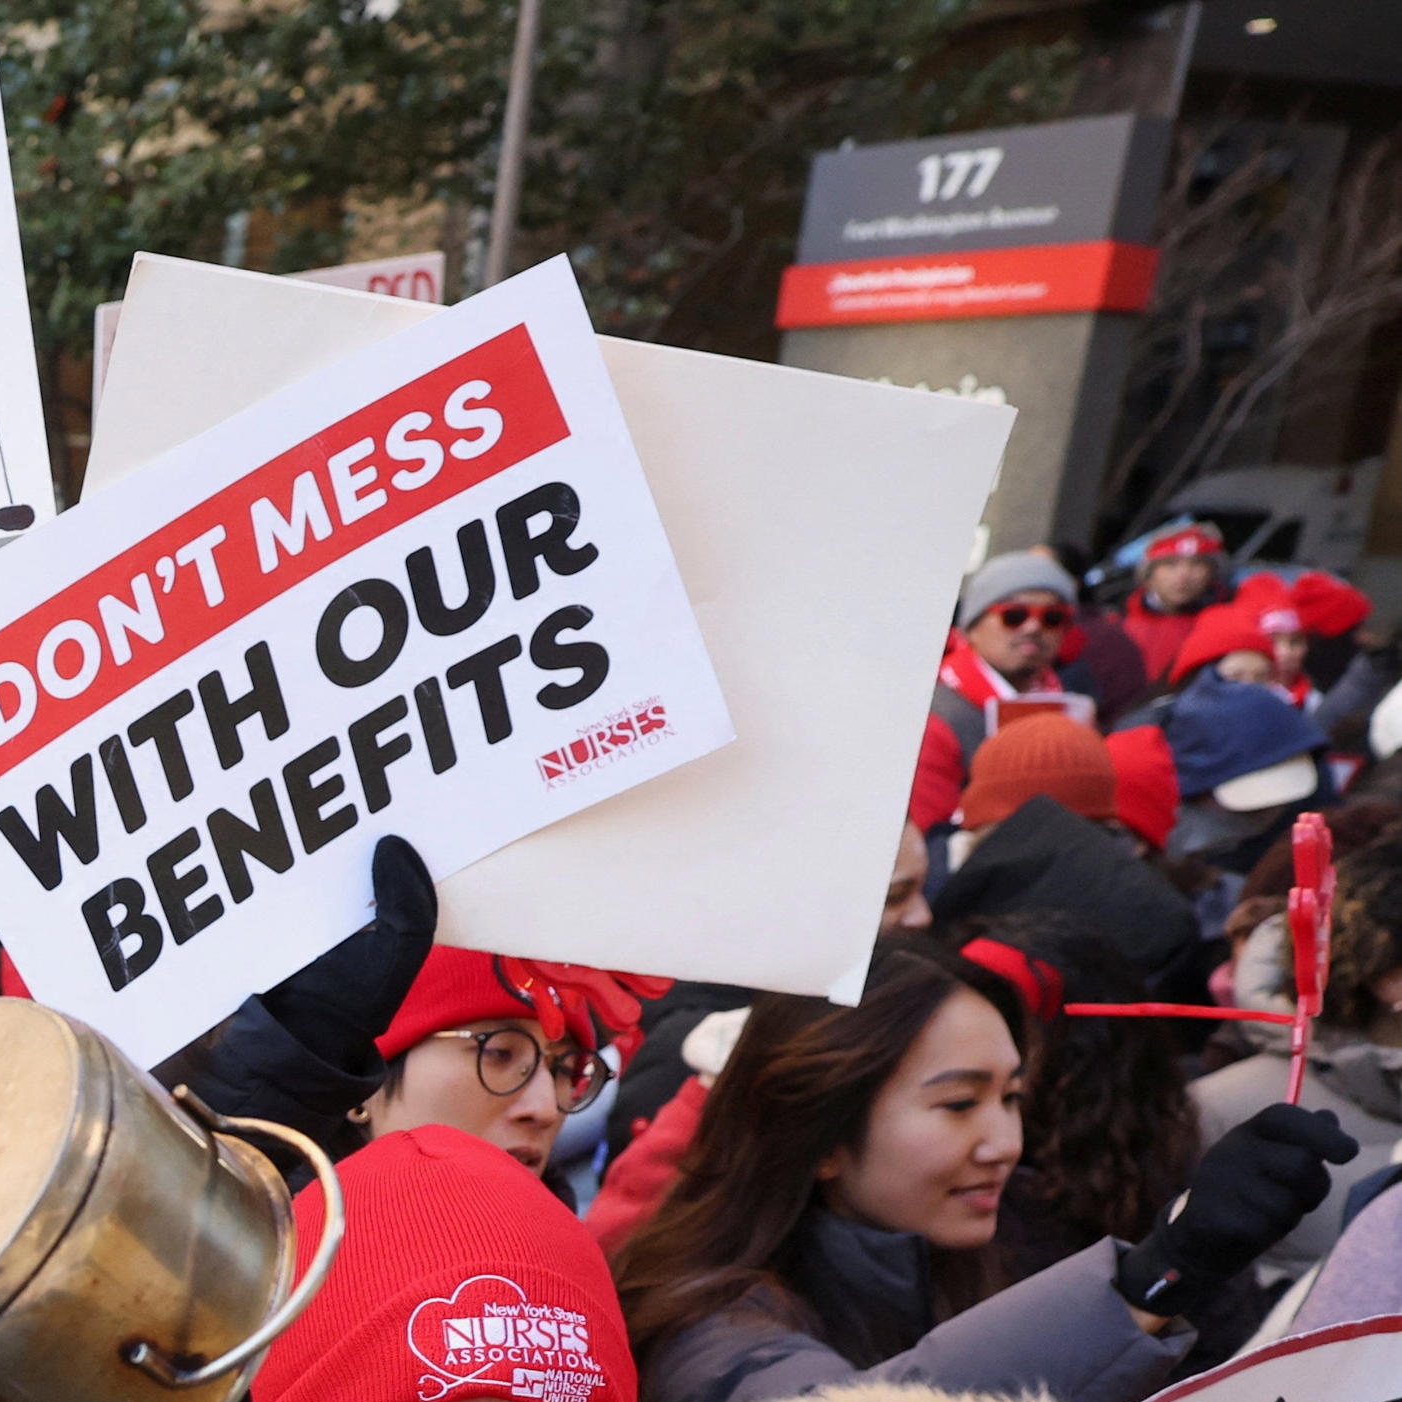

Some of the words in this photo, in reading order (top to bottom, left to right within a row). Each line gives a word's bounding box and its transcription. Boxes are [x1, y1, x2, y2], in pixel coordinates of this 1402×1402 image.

[917, 147, 1004, 203] 177
[249, 378, 504, 574] MESS
[314, 481, 599, 688] OUR
[535, 705, 667, 783] NURSES
[546, 722, 678, 792] ASSOCIATION
[81, 604, 611, 993] BENEFITS
[442, 1317, 589, 1355] NURSES
[483, 1302, 521, 1318] New
[520, 1303, 552, 1319] York
[553, 1306, 587, 1326] State
[444, 1348, 597, 1371] ASSOCIATION
[546, 1368, 607, 1387] NATIONAL
[545, 1379, 592, 1397] NURSES
